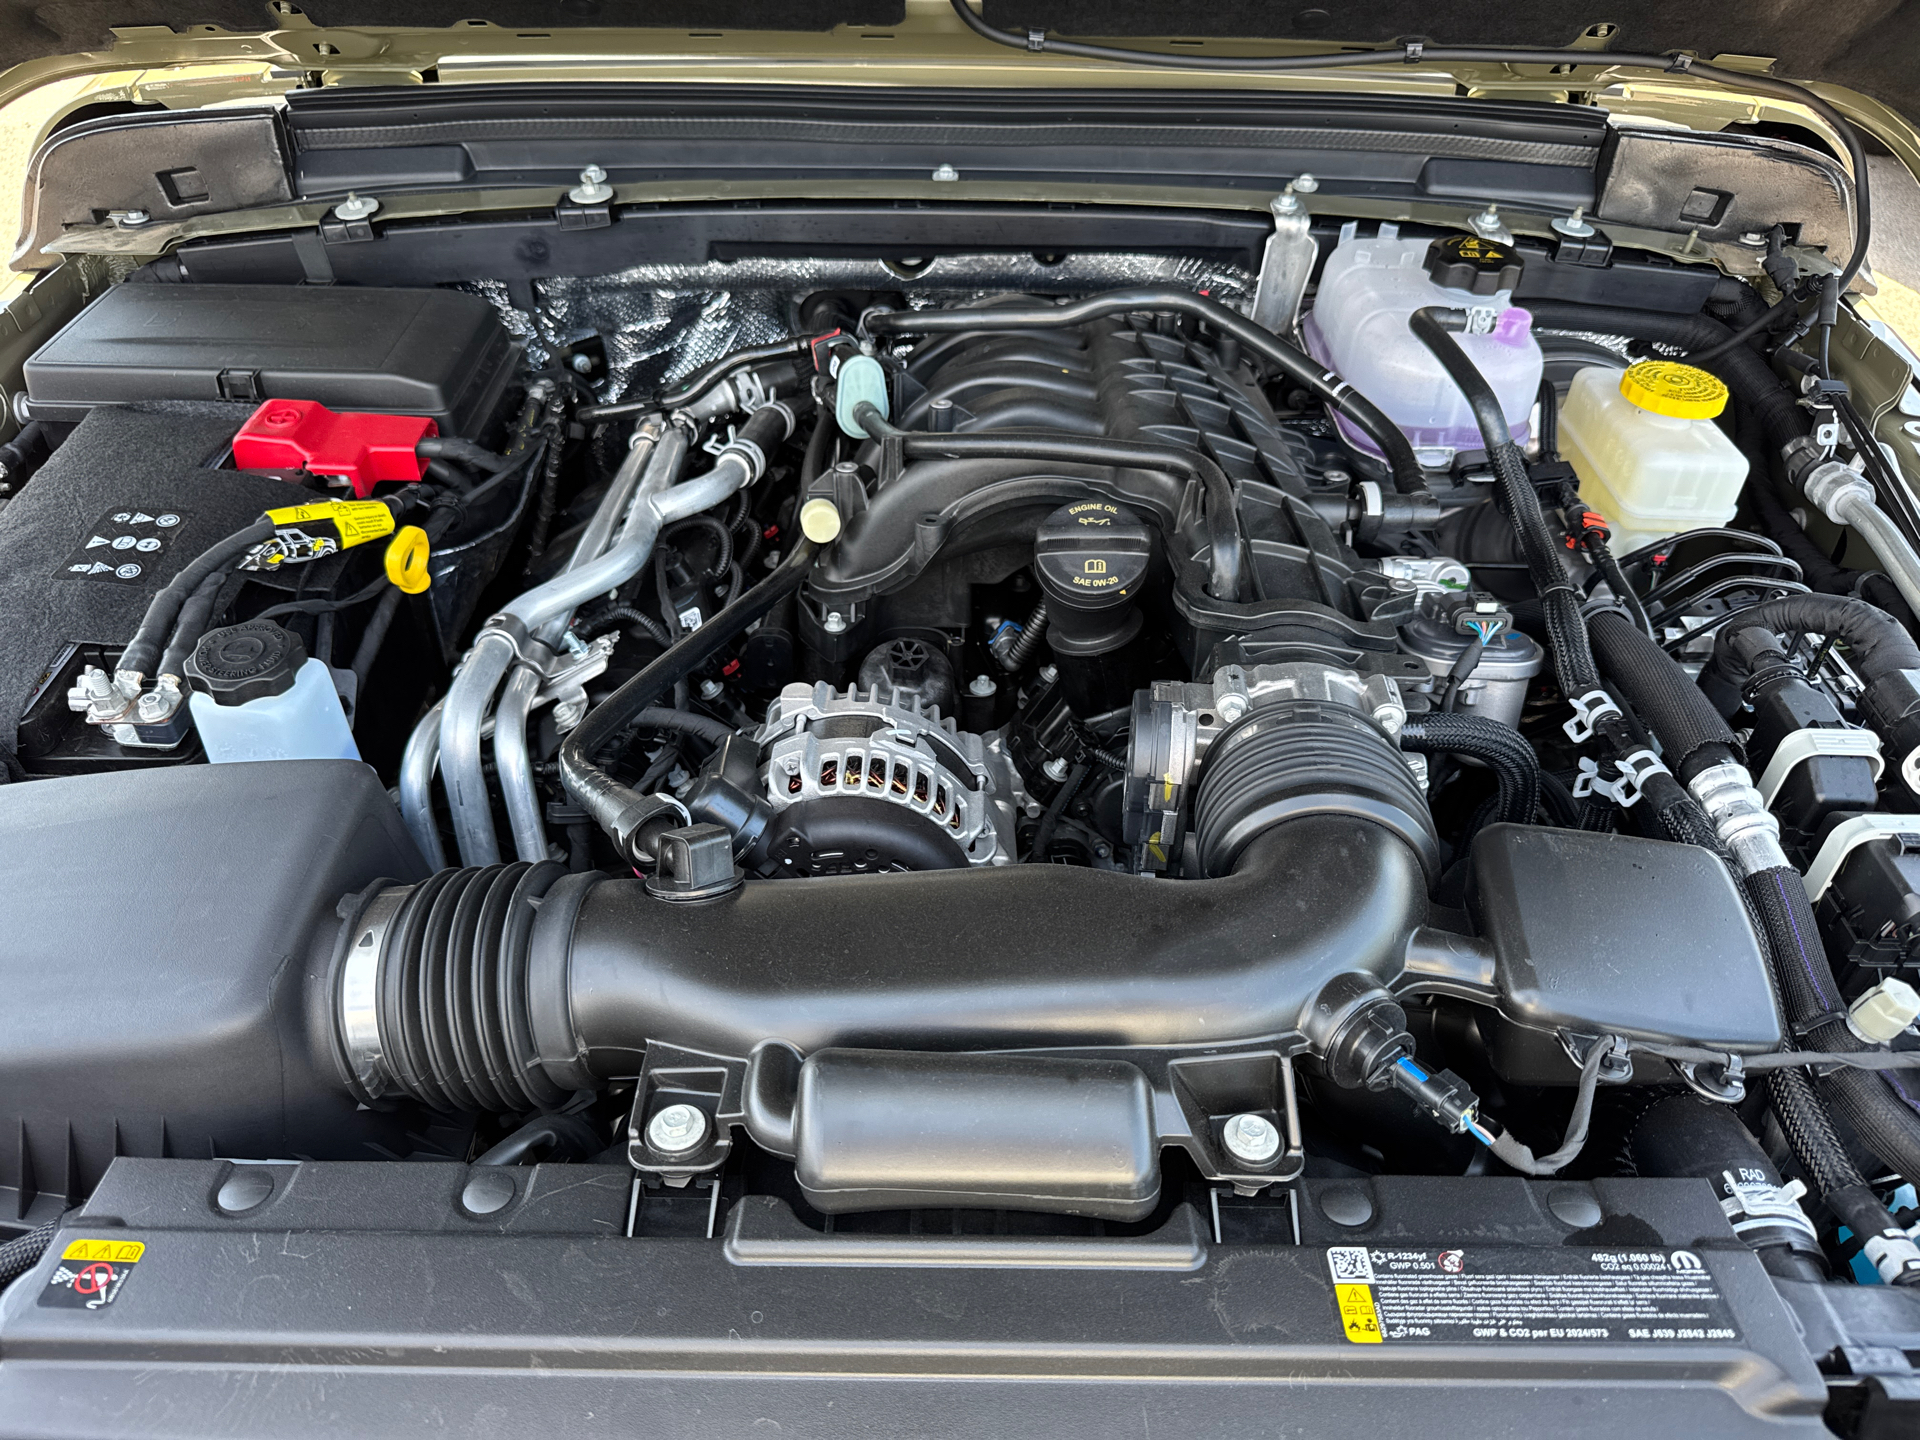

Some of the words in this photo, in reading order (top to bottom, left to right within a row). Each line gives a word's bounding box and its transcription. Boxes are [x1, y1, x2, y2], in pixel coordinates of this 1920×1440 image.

[1068, 503, 1102, 515] ENGINE
[1104, 505, 1118, 514] OIL
[1072, 576, 1092, 586] SAE
[1093, 576, 1118, 586] 0W-20
[240, 624, 284, 640] APPROVED
[208, 666, 257, 677] STEERING
[1739, 1168, 1765, 1181] RAD
[1387, 1252, 1427, 1261] R-1234yf
[1650, 1253, 1666, 1263] lb)
[1412, 1262, 1435, 1270] 0.501
[1600, 1263, 1620, 1271] CO2
[1621, 1264, 1633, 1272] eq
[1408, 1327, 1431, 1336] PAG
[1473, 1328, 1498, 1337] GWP
[1508, 1328, 1531, 1337] CO2
[1532, 1330, 1548, 1339] per
[1549, 1328, 1564, 1337] EU
[1628, 1328, 1651, 1338] SAE
